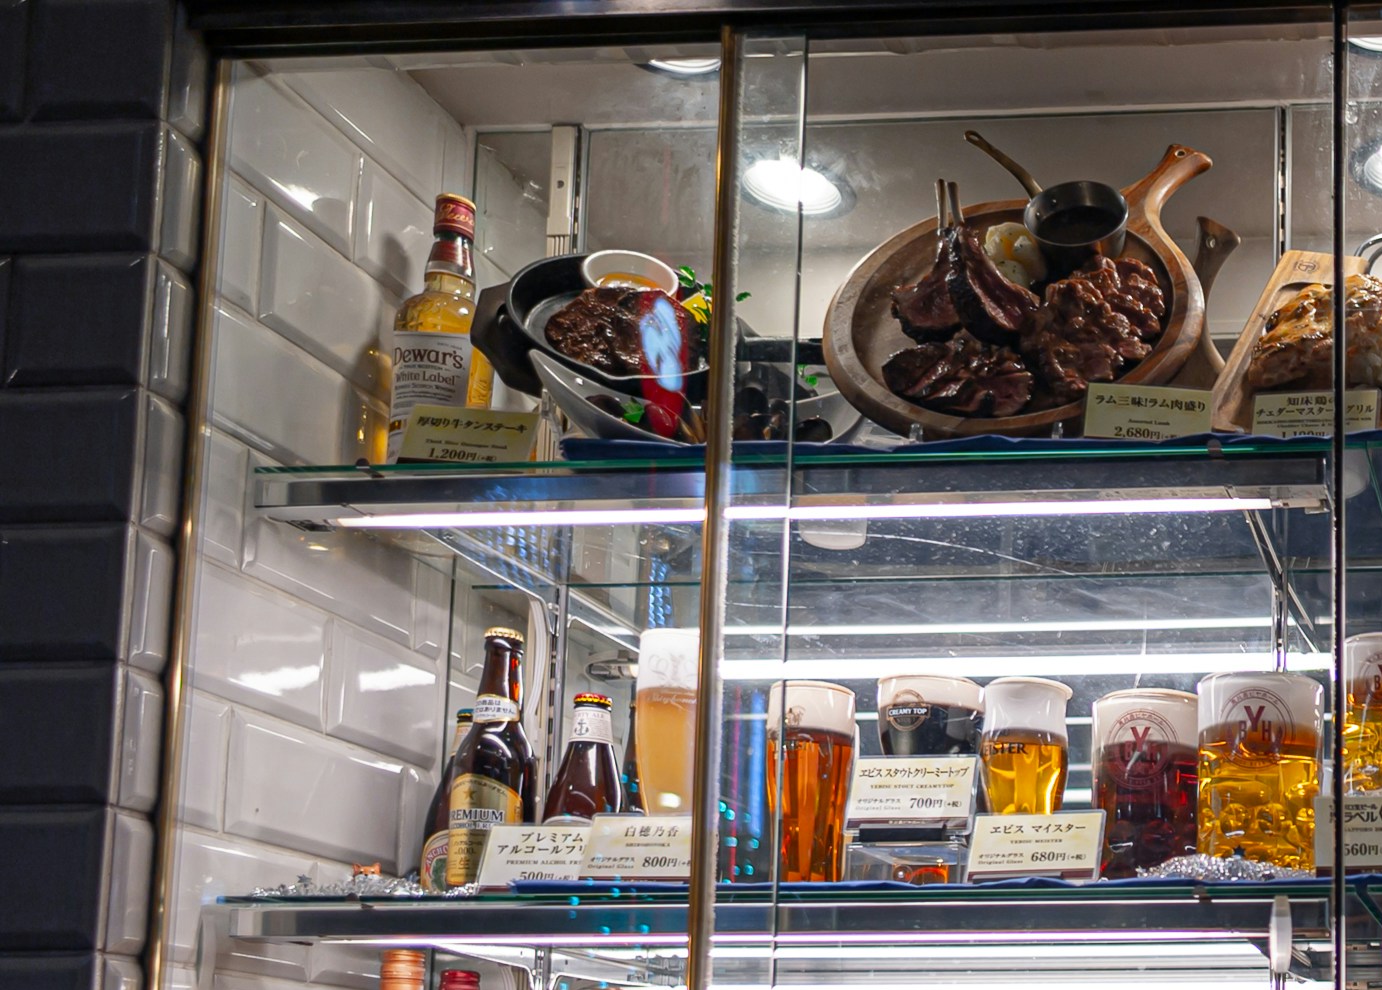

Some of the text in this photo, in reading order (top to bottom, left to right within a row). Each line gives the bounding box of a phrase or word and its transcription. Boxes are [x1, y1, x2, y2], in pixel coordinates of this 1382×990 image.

[423, 371, 456, 386] Label
[416, 416, 528, 434] 厚切り牛タンステーキ
[888, 707, 928, 718] CREAMY TOP
[886, 766, 970, 778] スタウトクリーミートップ
[624, 826, 679, 838] 白穂乃香
[1031, 823, 1087, 834] マイスター
[520, 832, 583, 843] プレミアム
[1031, 851, 1087, 863] 680円(+税)
